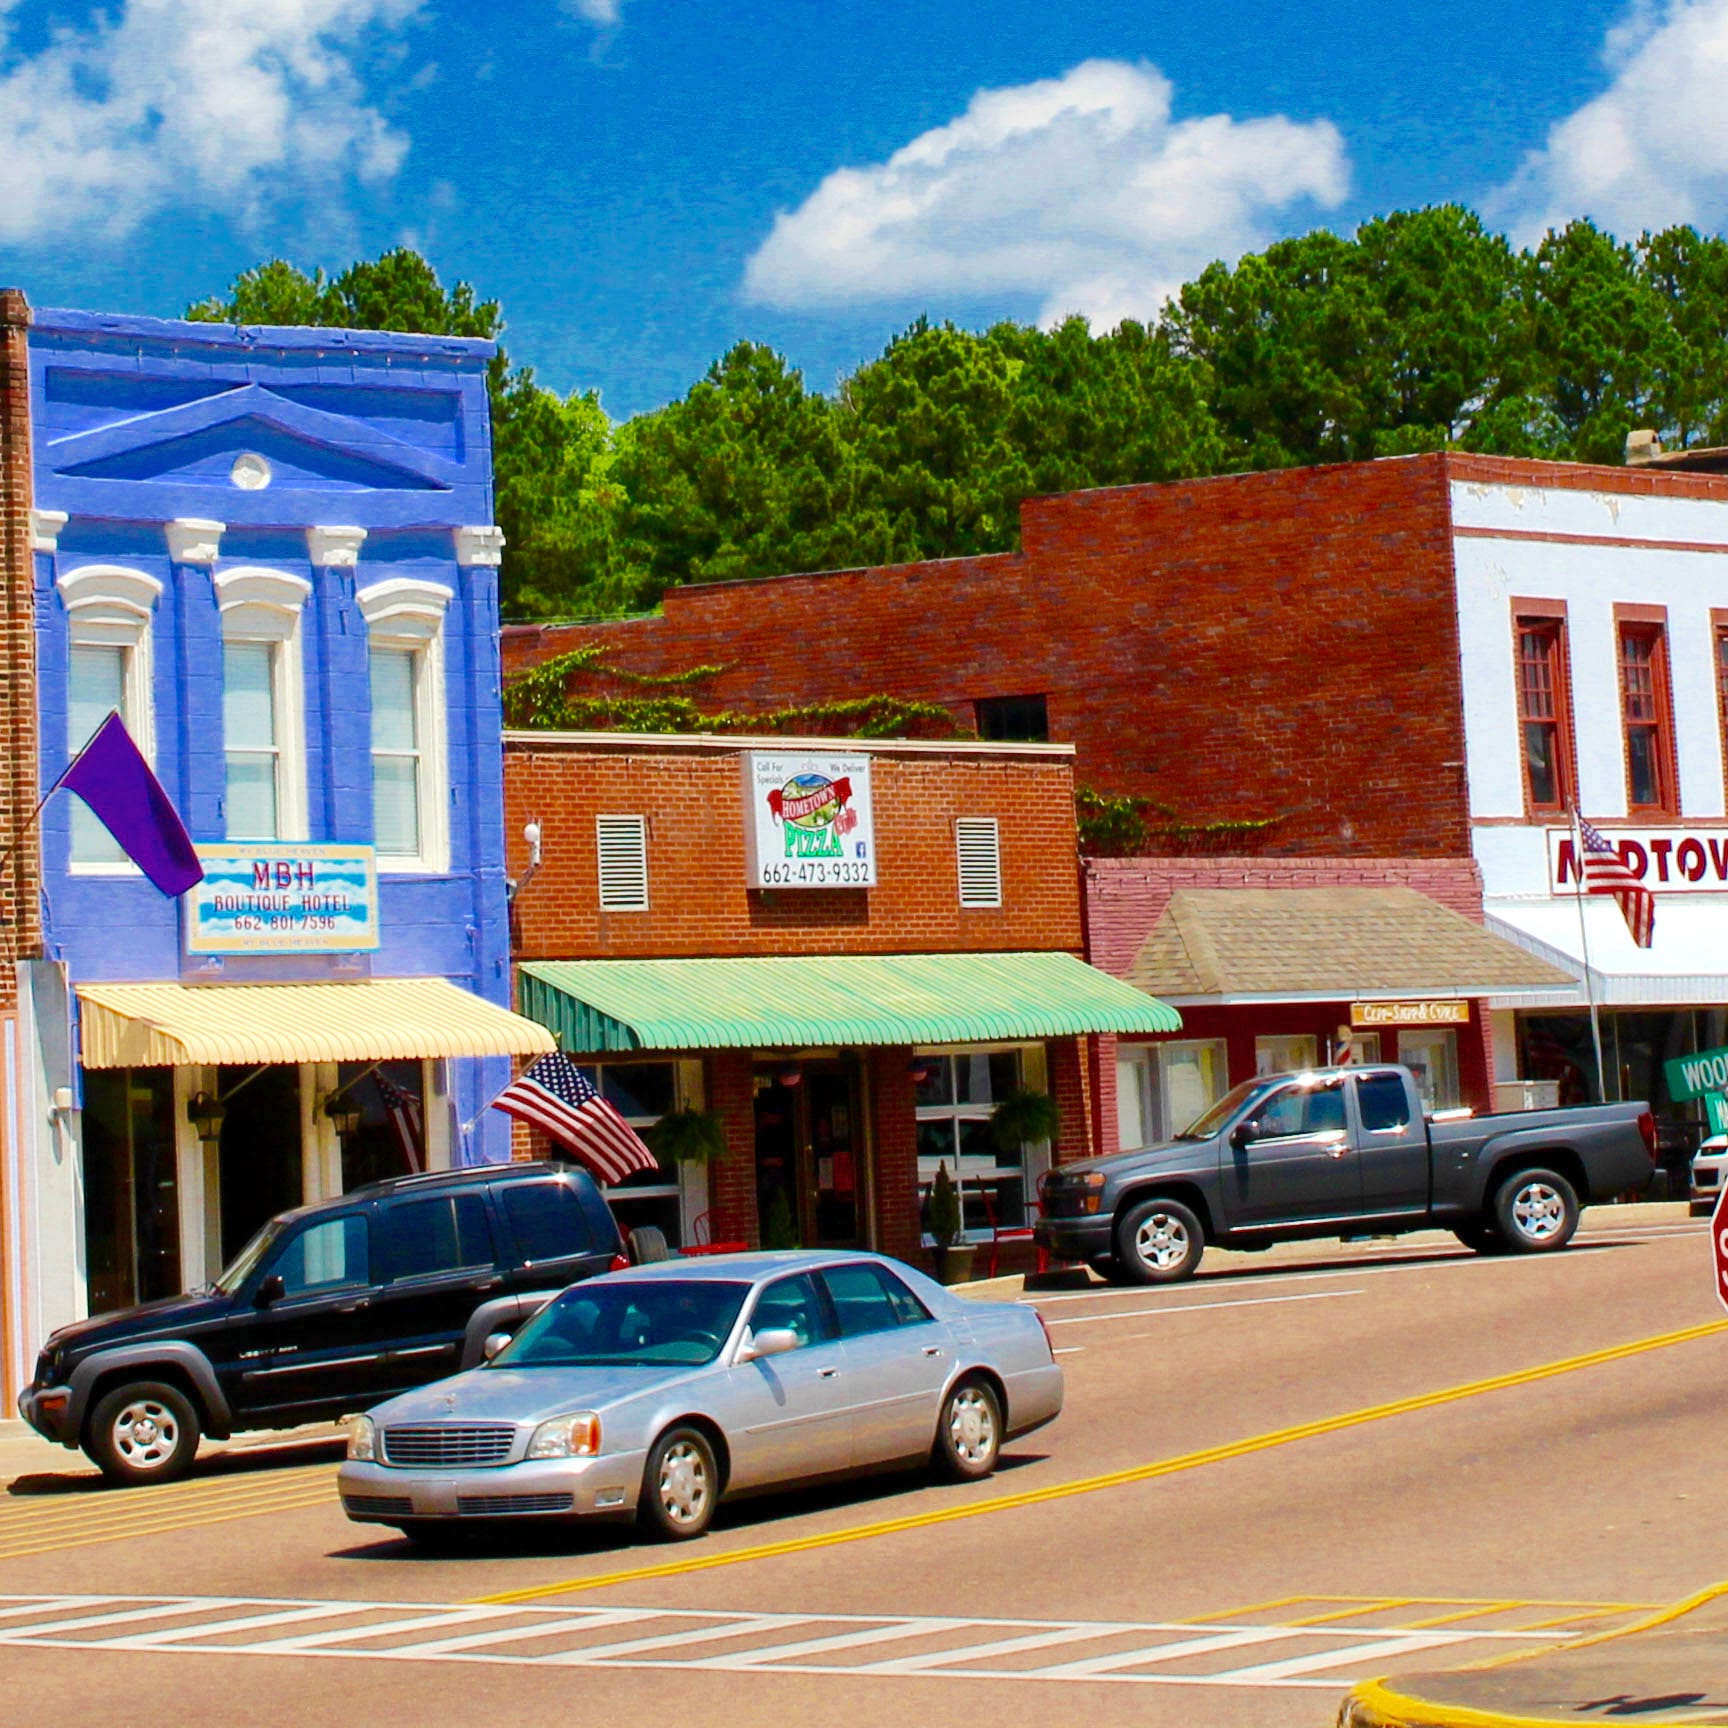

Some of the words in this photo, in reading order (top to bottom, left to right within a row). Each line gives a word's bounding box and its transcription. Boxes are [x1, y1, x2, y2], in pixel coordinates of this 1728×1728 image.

[783, 784, 836, 819] HOMETOWN
[783, 821, 844, 858] PIZZA
[253, 861, 315, 889] MBH
[763, 863, 870, 883] 662-473-9332
[214, 894, 291, 913] BOUTIQUE
[301, 895, 351, 911] HOTEL
